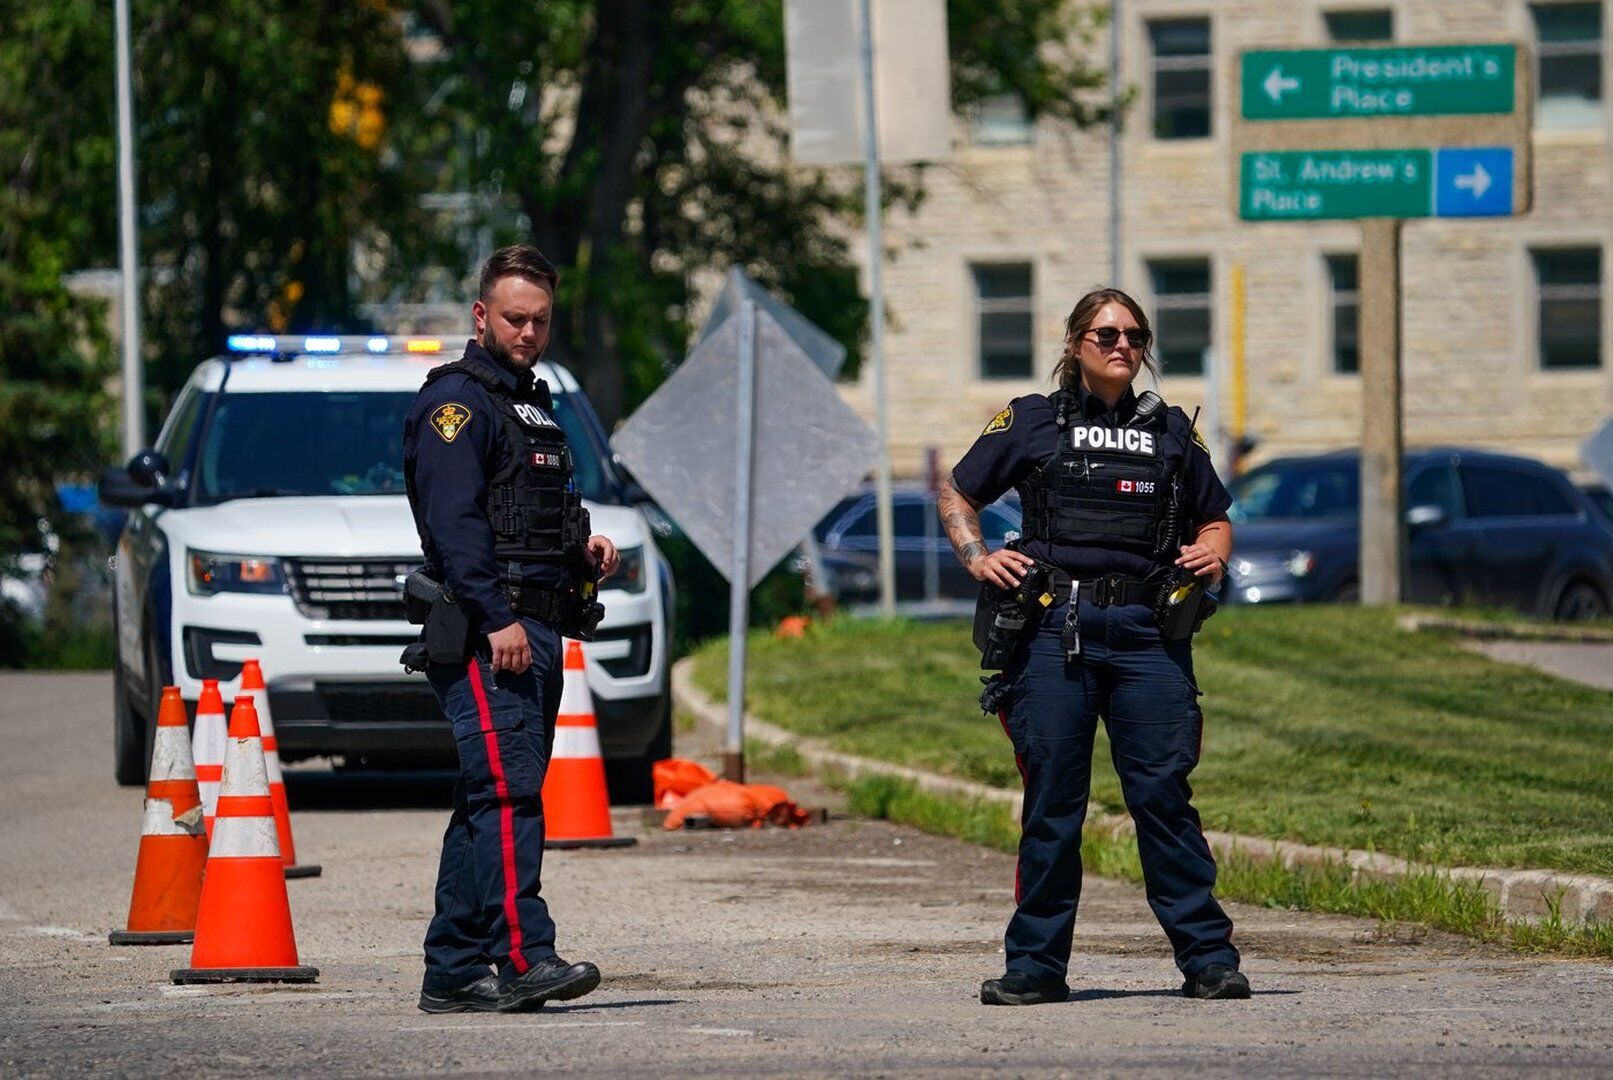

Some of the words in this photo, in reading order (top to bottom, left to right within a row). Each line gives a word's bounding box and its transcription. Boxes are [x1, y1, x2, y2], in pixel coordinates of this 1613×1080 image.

[1332, 85, 1412, 109] Place
[1252, 188, 1321, 212] Place
[1074, 426, 1153, 454] POLICE
[1135, 481, 1155, 493] 1055
